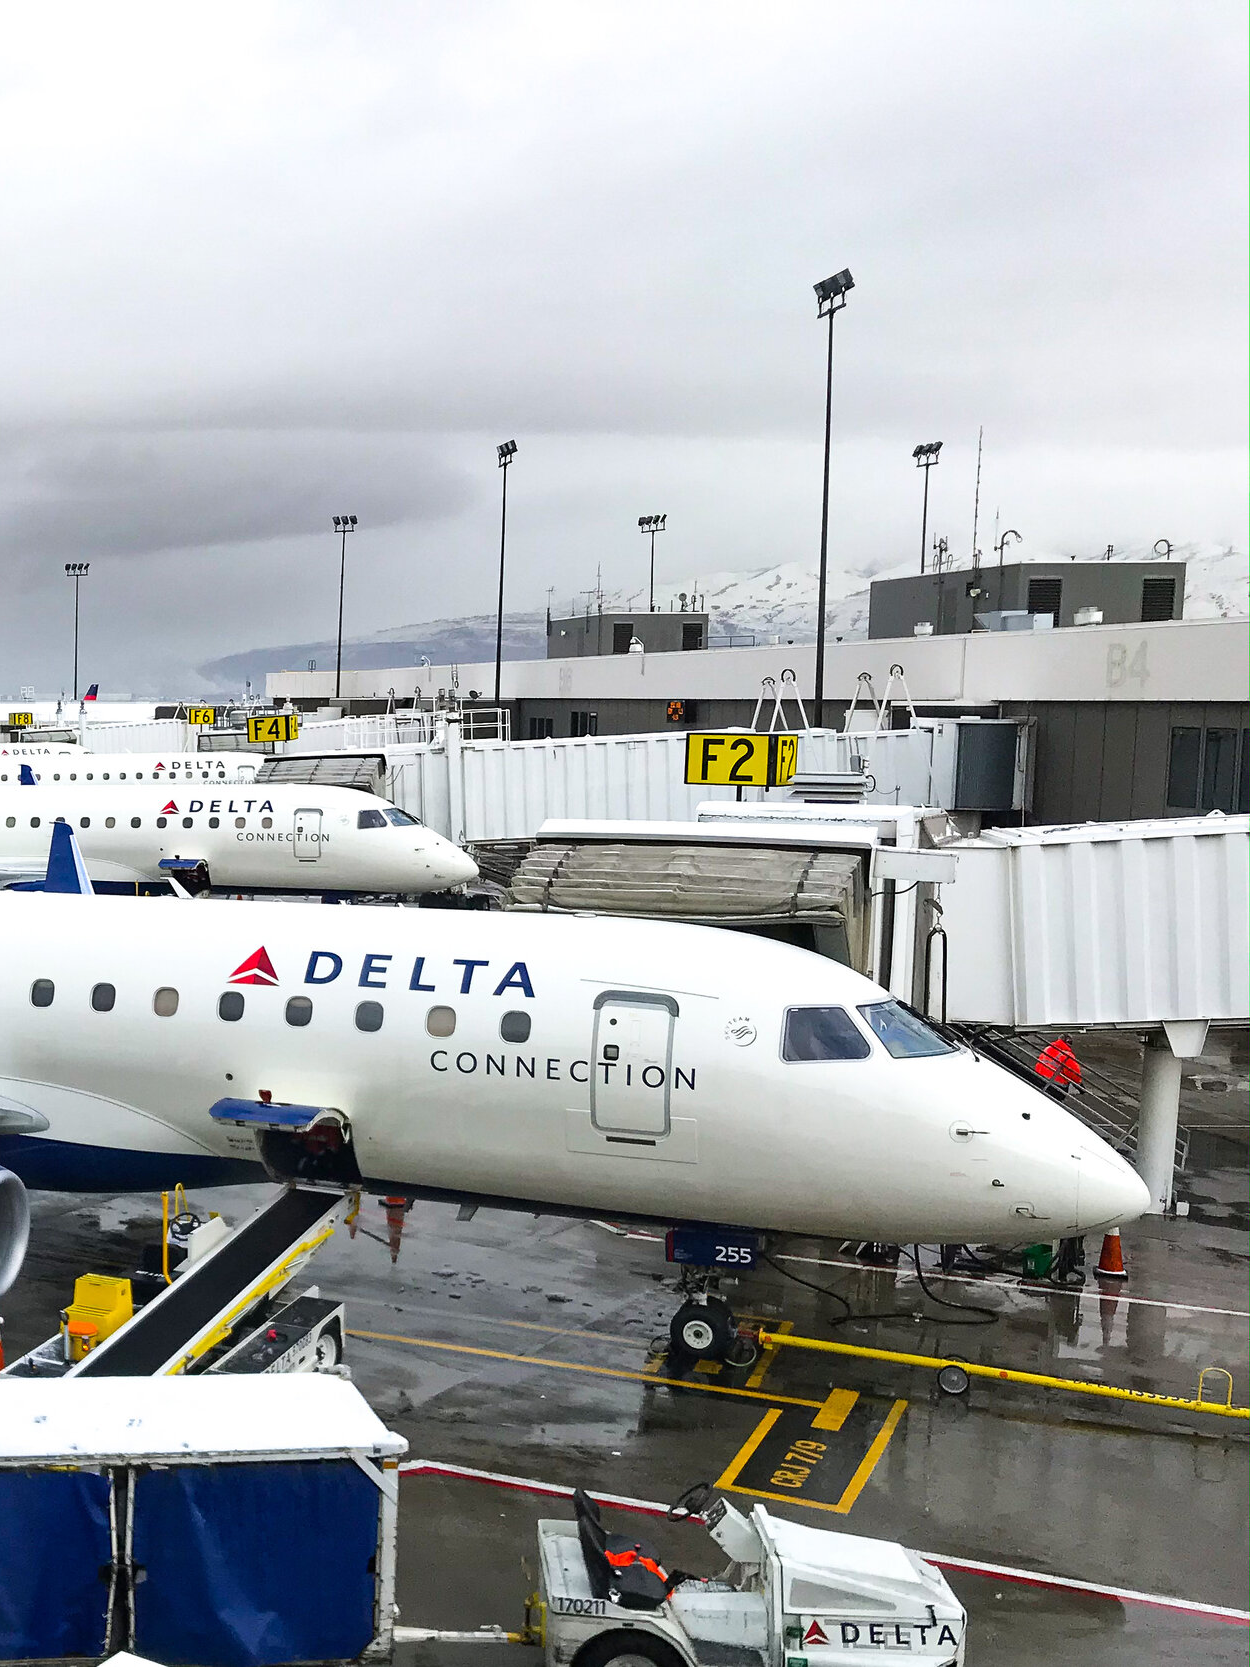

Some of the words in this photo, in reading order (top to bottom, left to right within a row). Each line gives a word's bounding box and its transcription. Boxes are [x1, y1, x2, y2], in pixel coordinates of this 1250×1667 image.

[1106, 641, 1151, 688] B4
[18, 714, 30, 723] F8
[194, 711, 210, 722] F6
[254, 718, 280, 740] F4
[172, 761, 225, 769] DELTA
[701, 738, 754, 781] F2
[780, 739, 794, 782] F2
[189, 800, 273, 812] DELTA
[237, 833, 330, 842] CONNECTION
[304, 951, 535, 998] DELTA
[430, 1050, 696, 1090] CONNECTION
[715, 1246, 752, 1263] 255
[784, 1440, 827, 1465] 7/9
[770, 1463, 811, 1488] CRJ
[558, 1597, 606, 1614] 170211
[840, 1622, 957, 1646] DELTA
